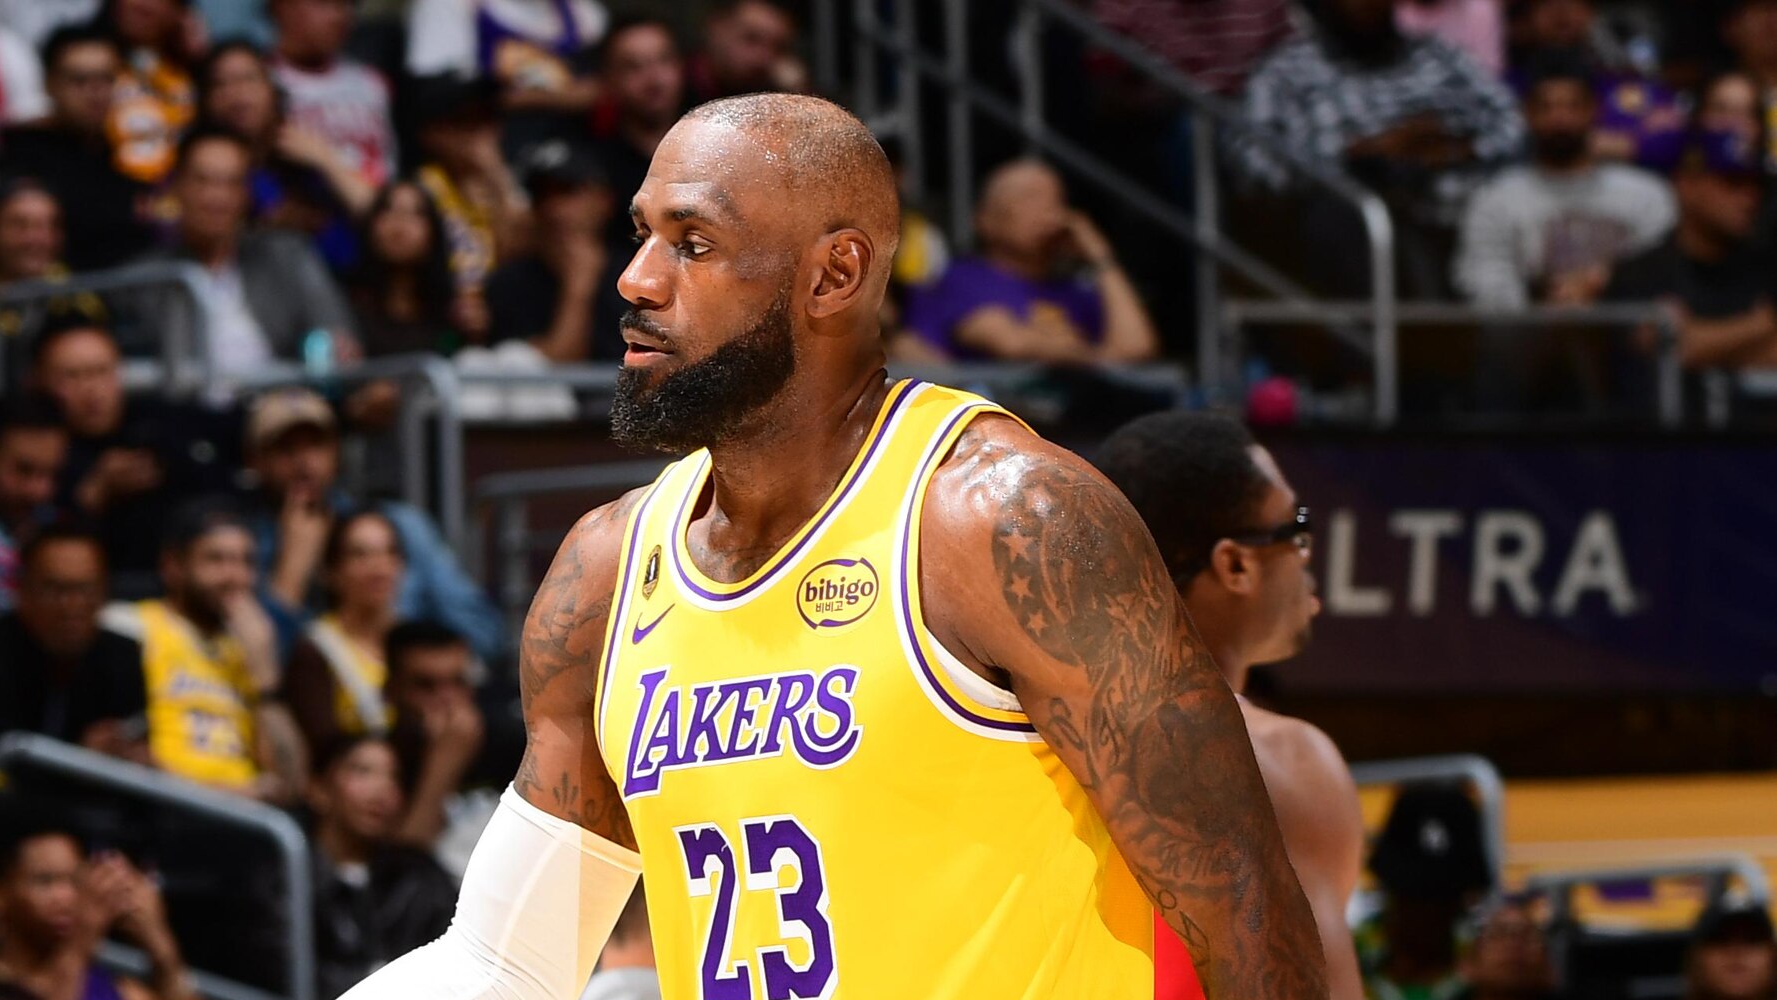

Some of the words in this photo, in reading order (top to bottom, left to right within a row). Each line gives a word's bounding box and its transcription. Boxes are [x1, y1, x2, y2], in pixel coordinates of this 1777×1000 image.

[805, 576, 874, 605] bibigo
[1325, 508, 1641, 617] LTRA
[815, 600, 844, 613] 비비고
[623, 664, 864, 803] LAKERS
